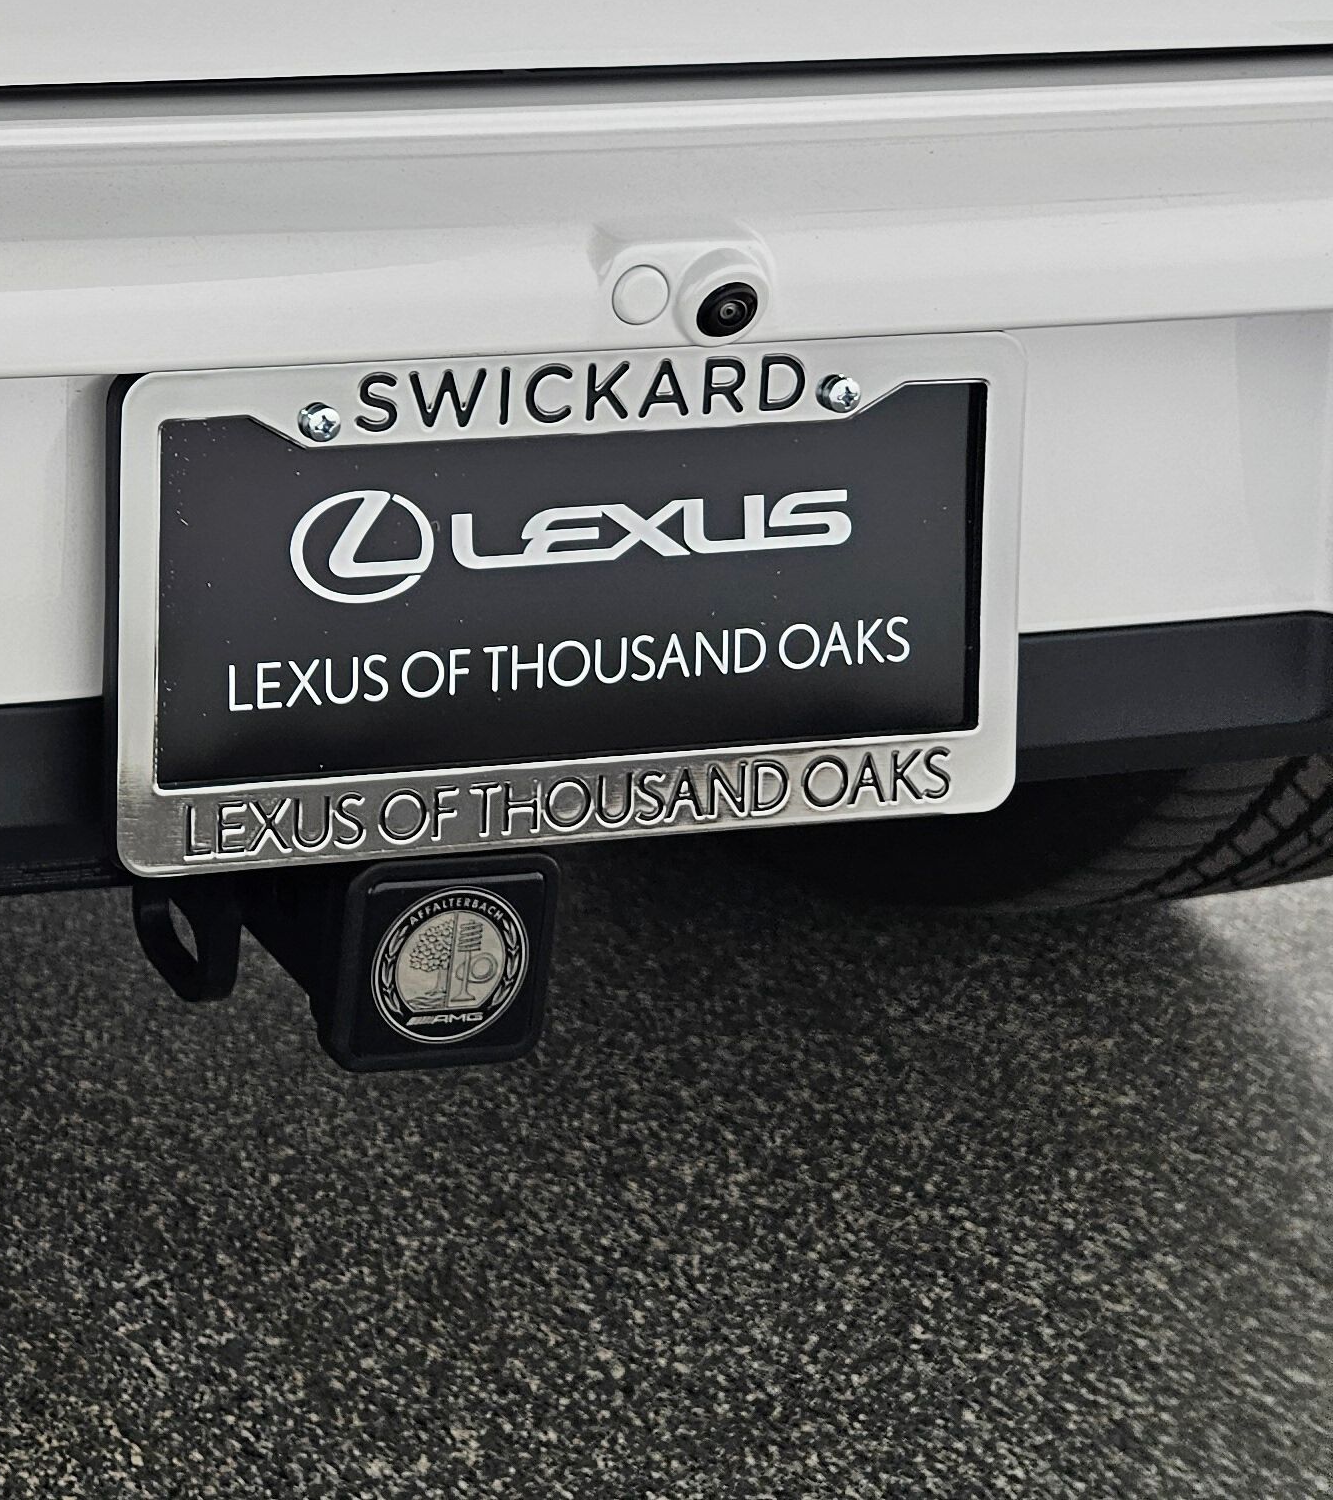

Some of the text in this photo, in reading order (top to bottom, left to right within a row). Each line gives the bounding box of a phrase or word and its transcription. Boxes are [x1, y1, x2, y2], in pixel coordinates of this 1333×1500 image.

[354, 354, 807, 434] SWICKARD
[450, 488, 853, 571] LEXUS
[228, 616, 911, 712] LEXUS OF THOUSAND OAKS
[182, 747, 953, 860] LEXUS OF THOUSAND OAKS
[409, 897, 504, 926] AFFALTERBACH
[431, 1012, 483, 1023] AMG
